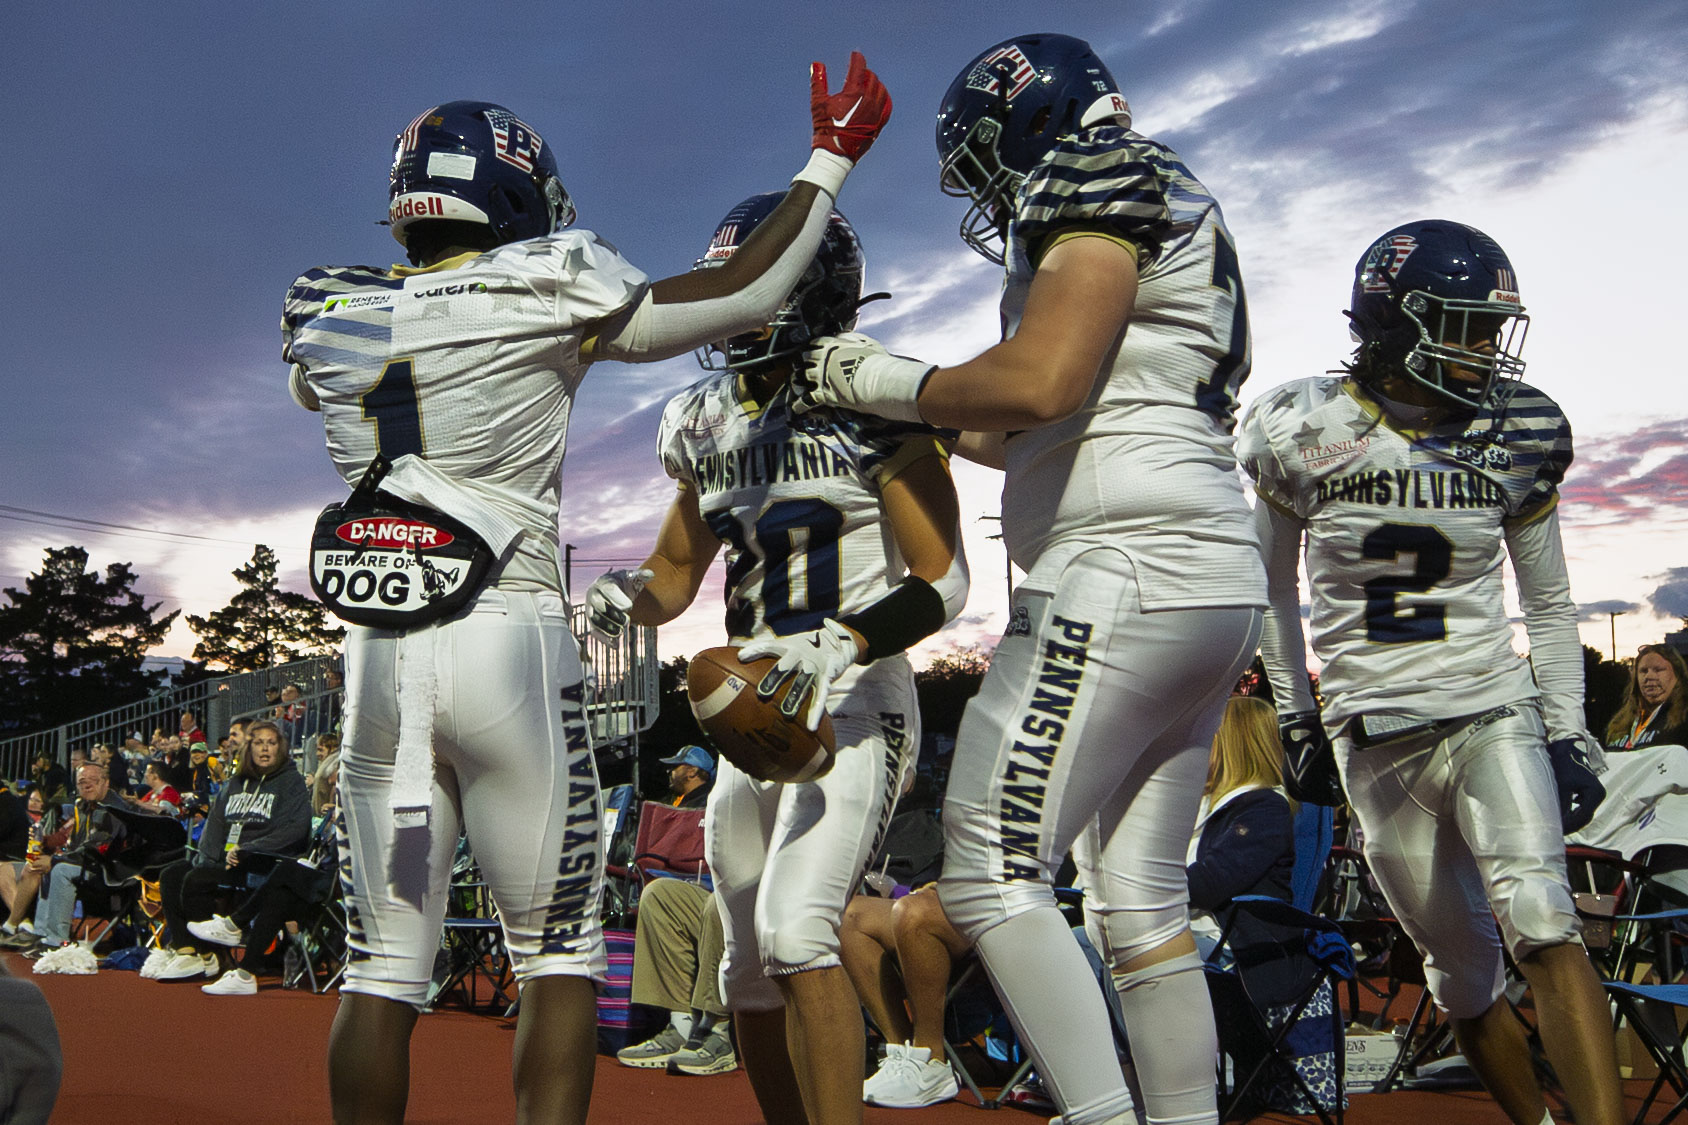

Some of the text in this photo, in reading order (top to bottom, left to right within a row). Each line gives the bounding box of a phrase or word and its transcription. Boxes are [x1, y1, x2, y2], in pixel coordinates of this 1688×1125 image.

[1091, 80, 1109, 92] 72
[359, 356, 427, 460] 1
[1302, 436, 1370, 460] TITANIUM
[689, 442, 850, 495] ENNSYLVANIA
[350, 522, 437, 545] DANGER
[324, 554, 388, 568] BEWARE
[321, 568, 411, 606] DOG
[1362, 520, 1456, 645] 2
